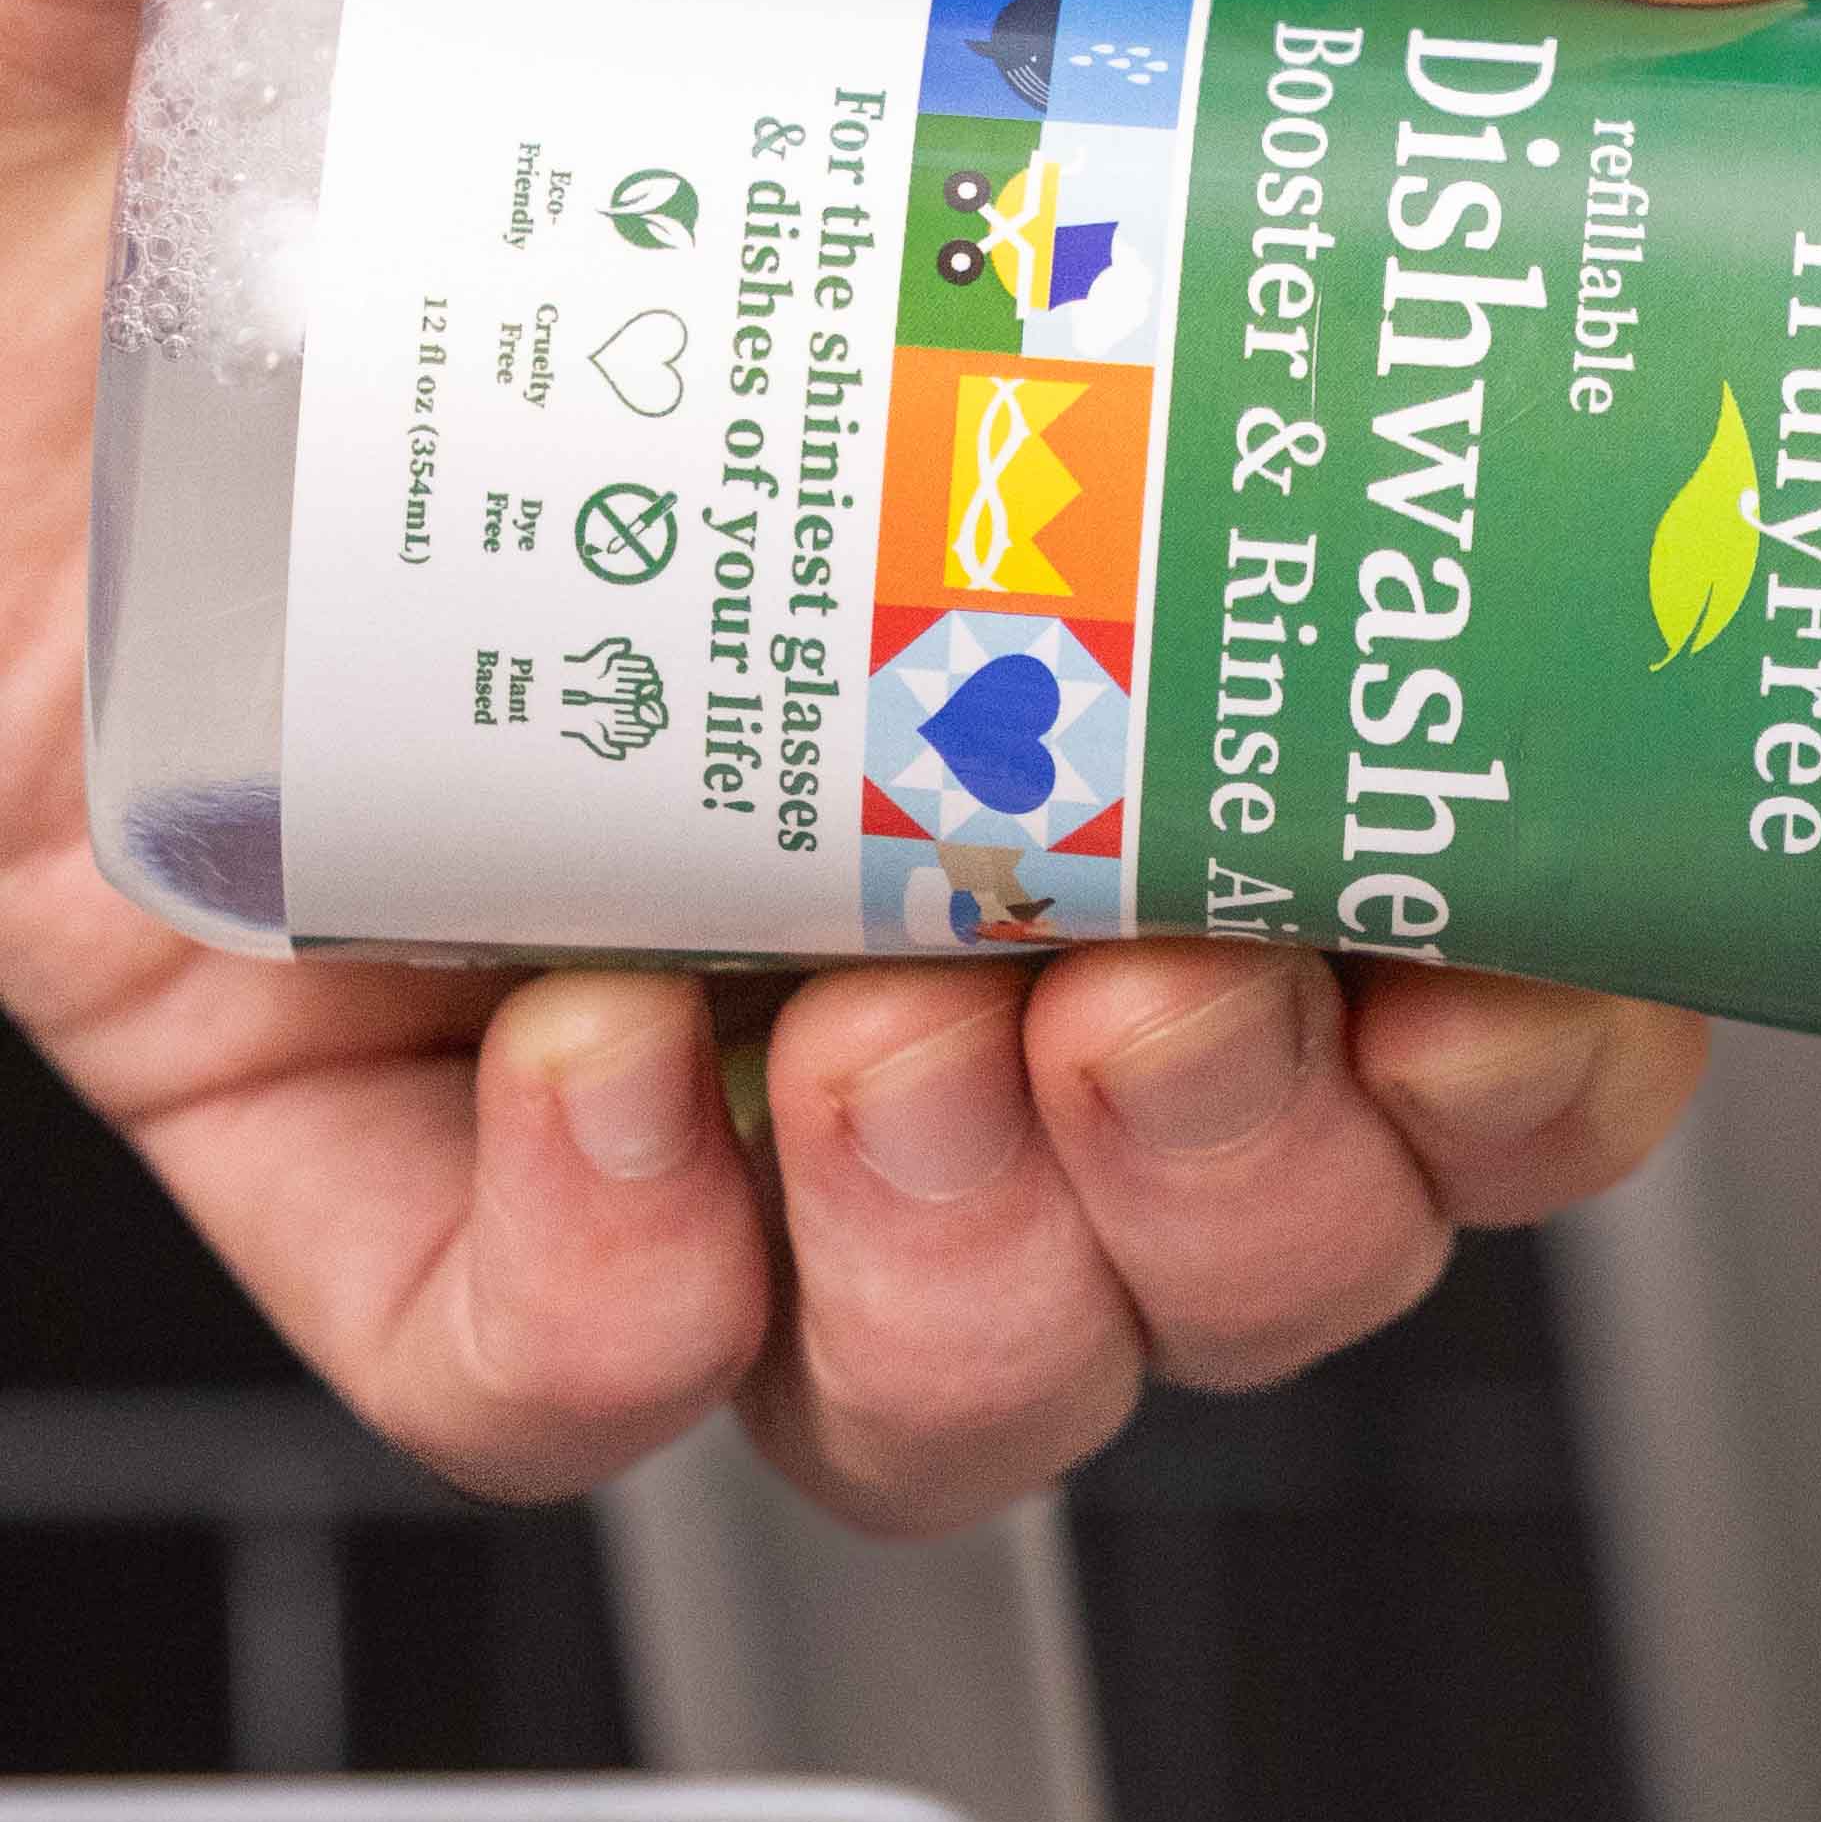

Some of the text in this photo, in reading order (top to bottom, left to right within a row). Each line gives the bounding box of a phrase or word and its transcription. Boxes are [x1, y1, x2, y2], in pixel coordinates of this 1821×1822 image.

[502, 141, 542, 250] Friendly
[546, 169, 573, 227] Eco-
[1568, 117, 1649, 415] refillable
[496, 323, 523, 384] Free
[522, 302, 559, 409] Cruelty
[398, 298, 447, 566] 12 fl oz (354mL)
[701, 115, 806, 814] & dishes of your life!
[769, 87, 887, 854] For the shiniest glasses
[1206, 21, 1365, 942] Booster & Rinse Ai
[482, 491, 510, 554] Free
[512, 498, 543, 552] Dye
[473, 649, 500, 726] Based
[507, 657, 535, 724] Plant
